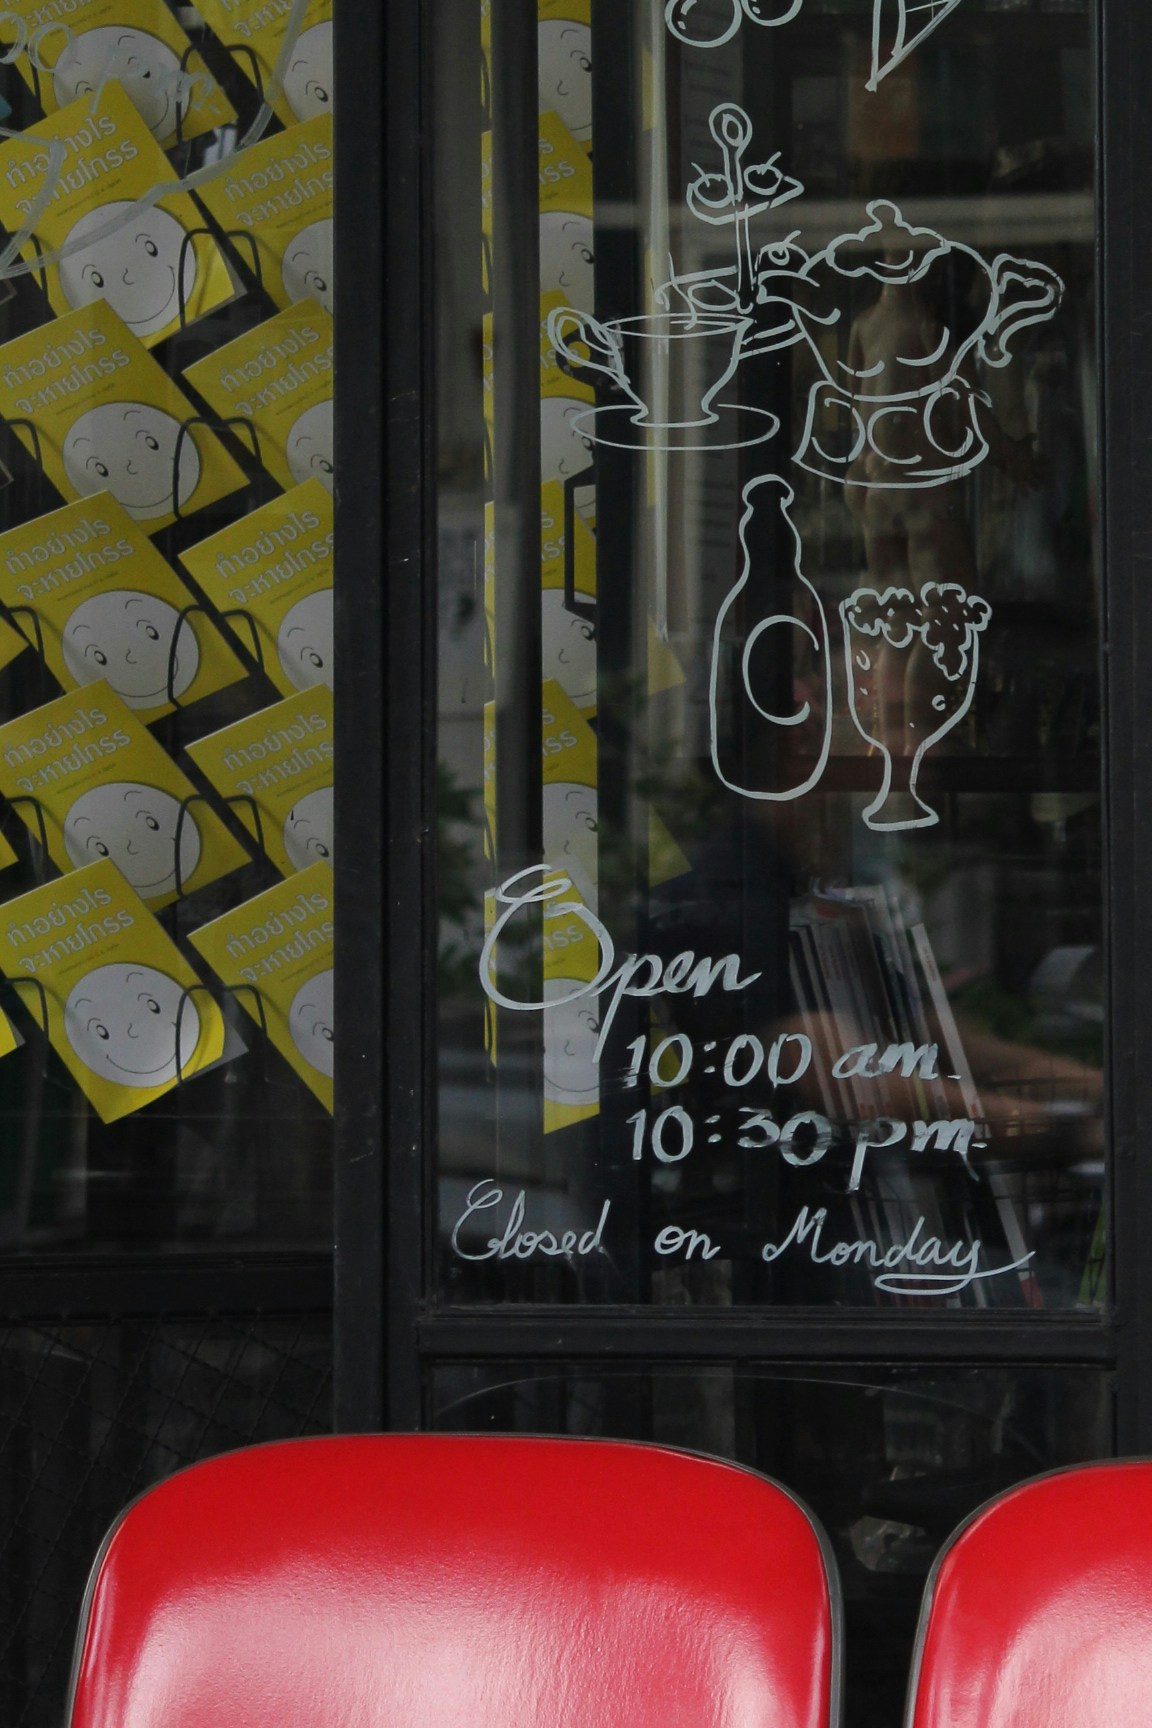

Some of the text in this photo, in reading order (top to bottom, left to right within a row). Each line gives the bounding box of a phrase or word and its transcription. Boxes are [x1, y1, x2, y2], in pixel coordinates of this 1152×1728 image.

[478, 863, 763, 1063] Open
[621, 1031, 812, 1088] 10:00
[626, 1105, 833, 1166] 10:30
[451, 1178, 1036, 1295] Closed on Monday
